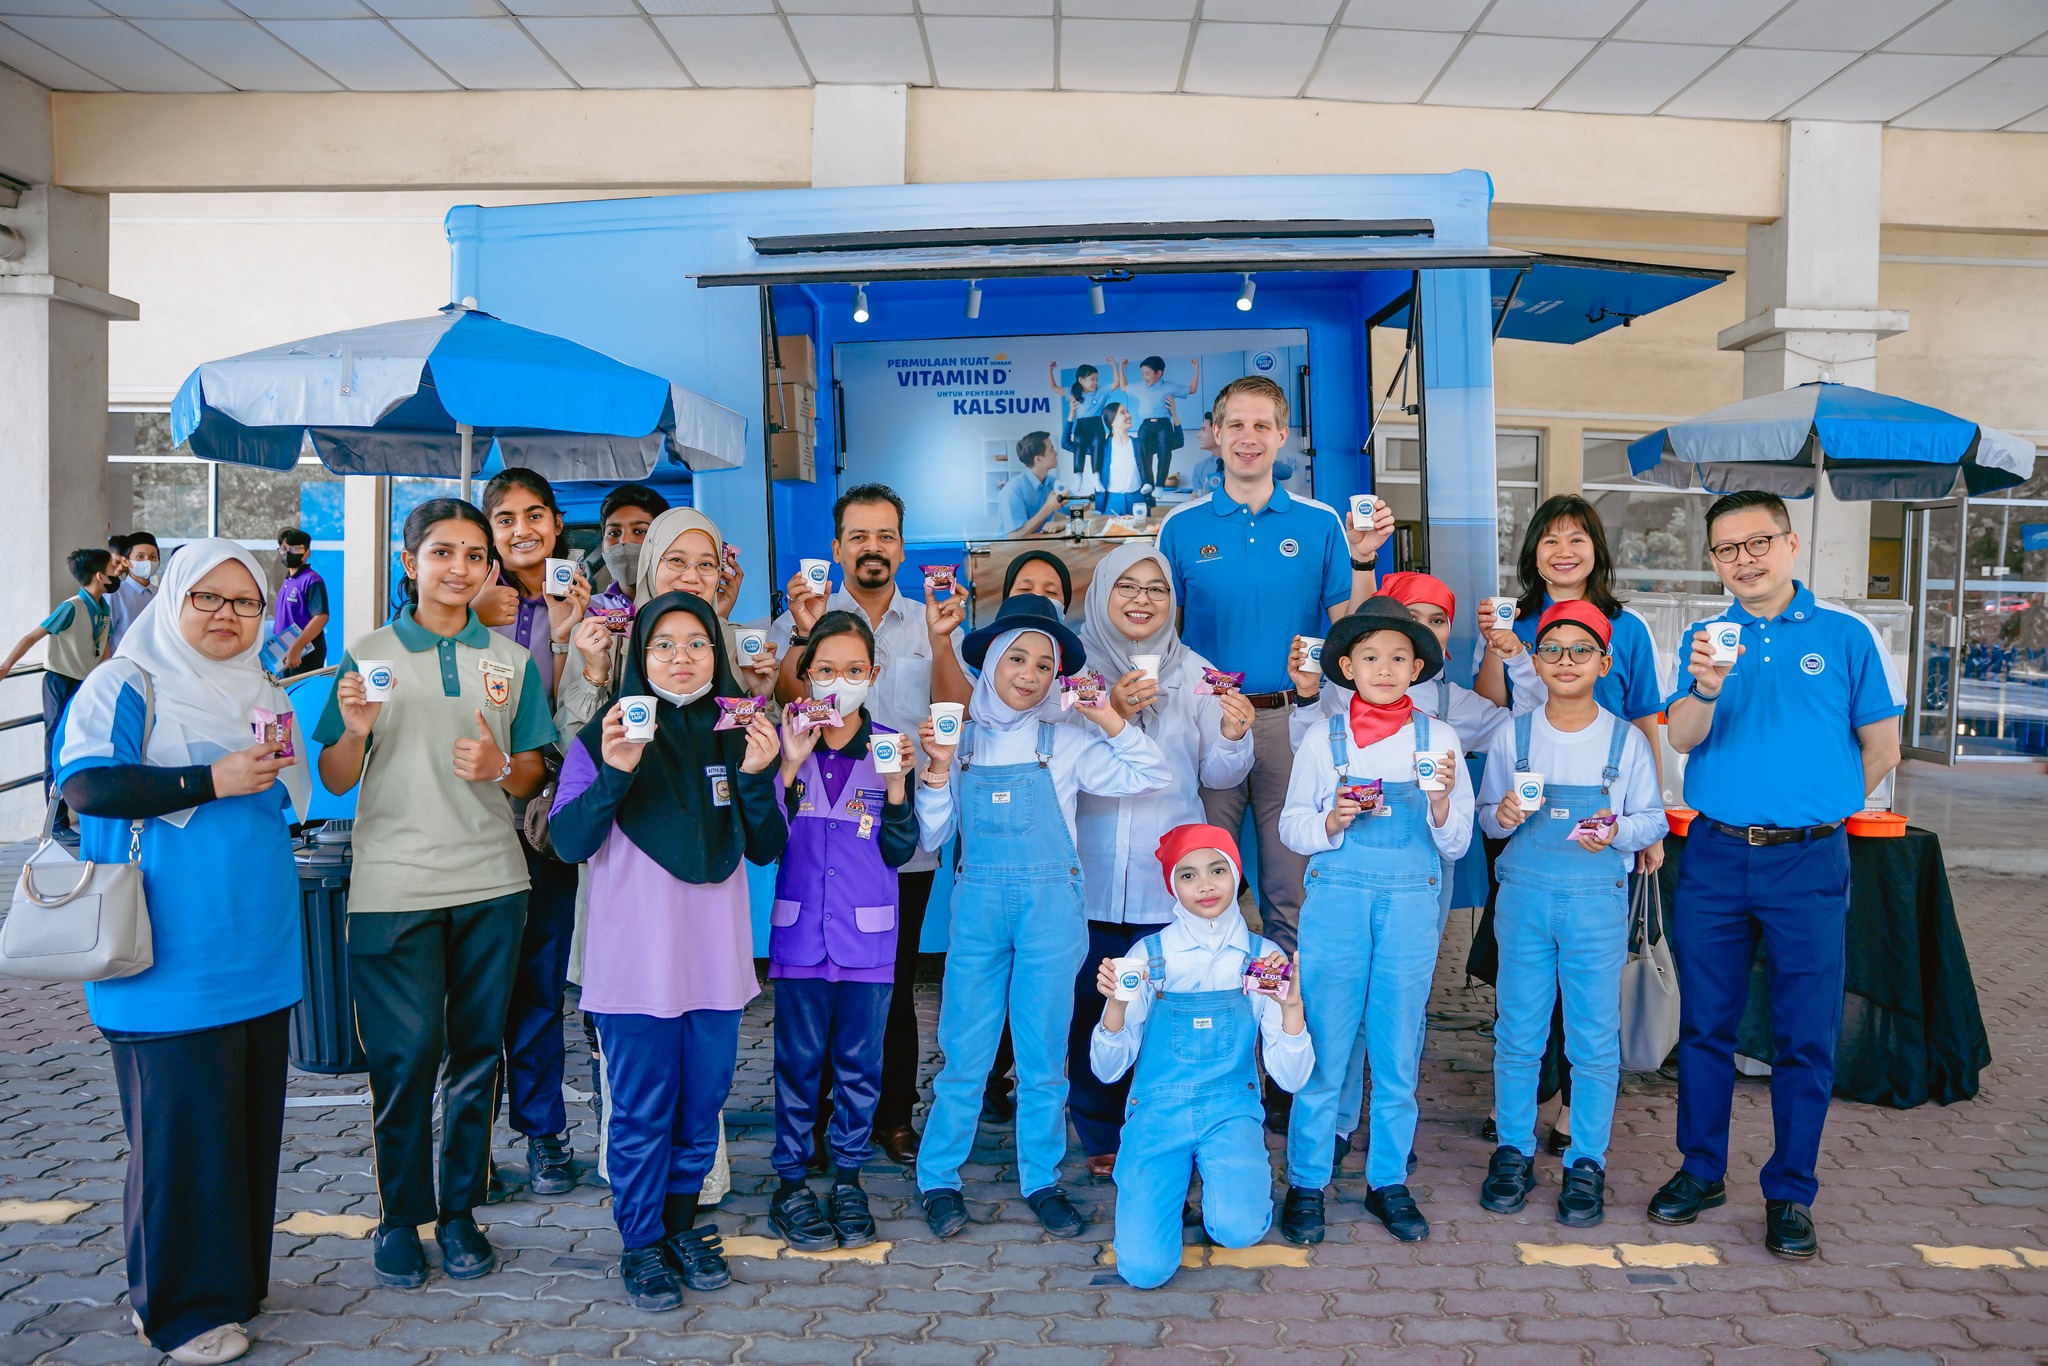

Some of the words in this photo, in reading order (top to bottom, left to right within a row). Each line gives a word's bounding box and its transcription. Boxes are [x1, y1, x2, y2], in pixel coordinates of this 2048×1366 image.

[887, 358, 957, 368] PERMULAAN
[960, 357, 989, 366] KUAT
[897, 369, 988, 387] VITAMIN
[953, 397, 1050, 415] KALSIUM
[1360, 794, 1378, 802] LEXUS
[1260, 972, 1282, 981] LEXUS
